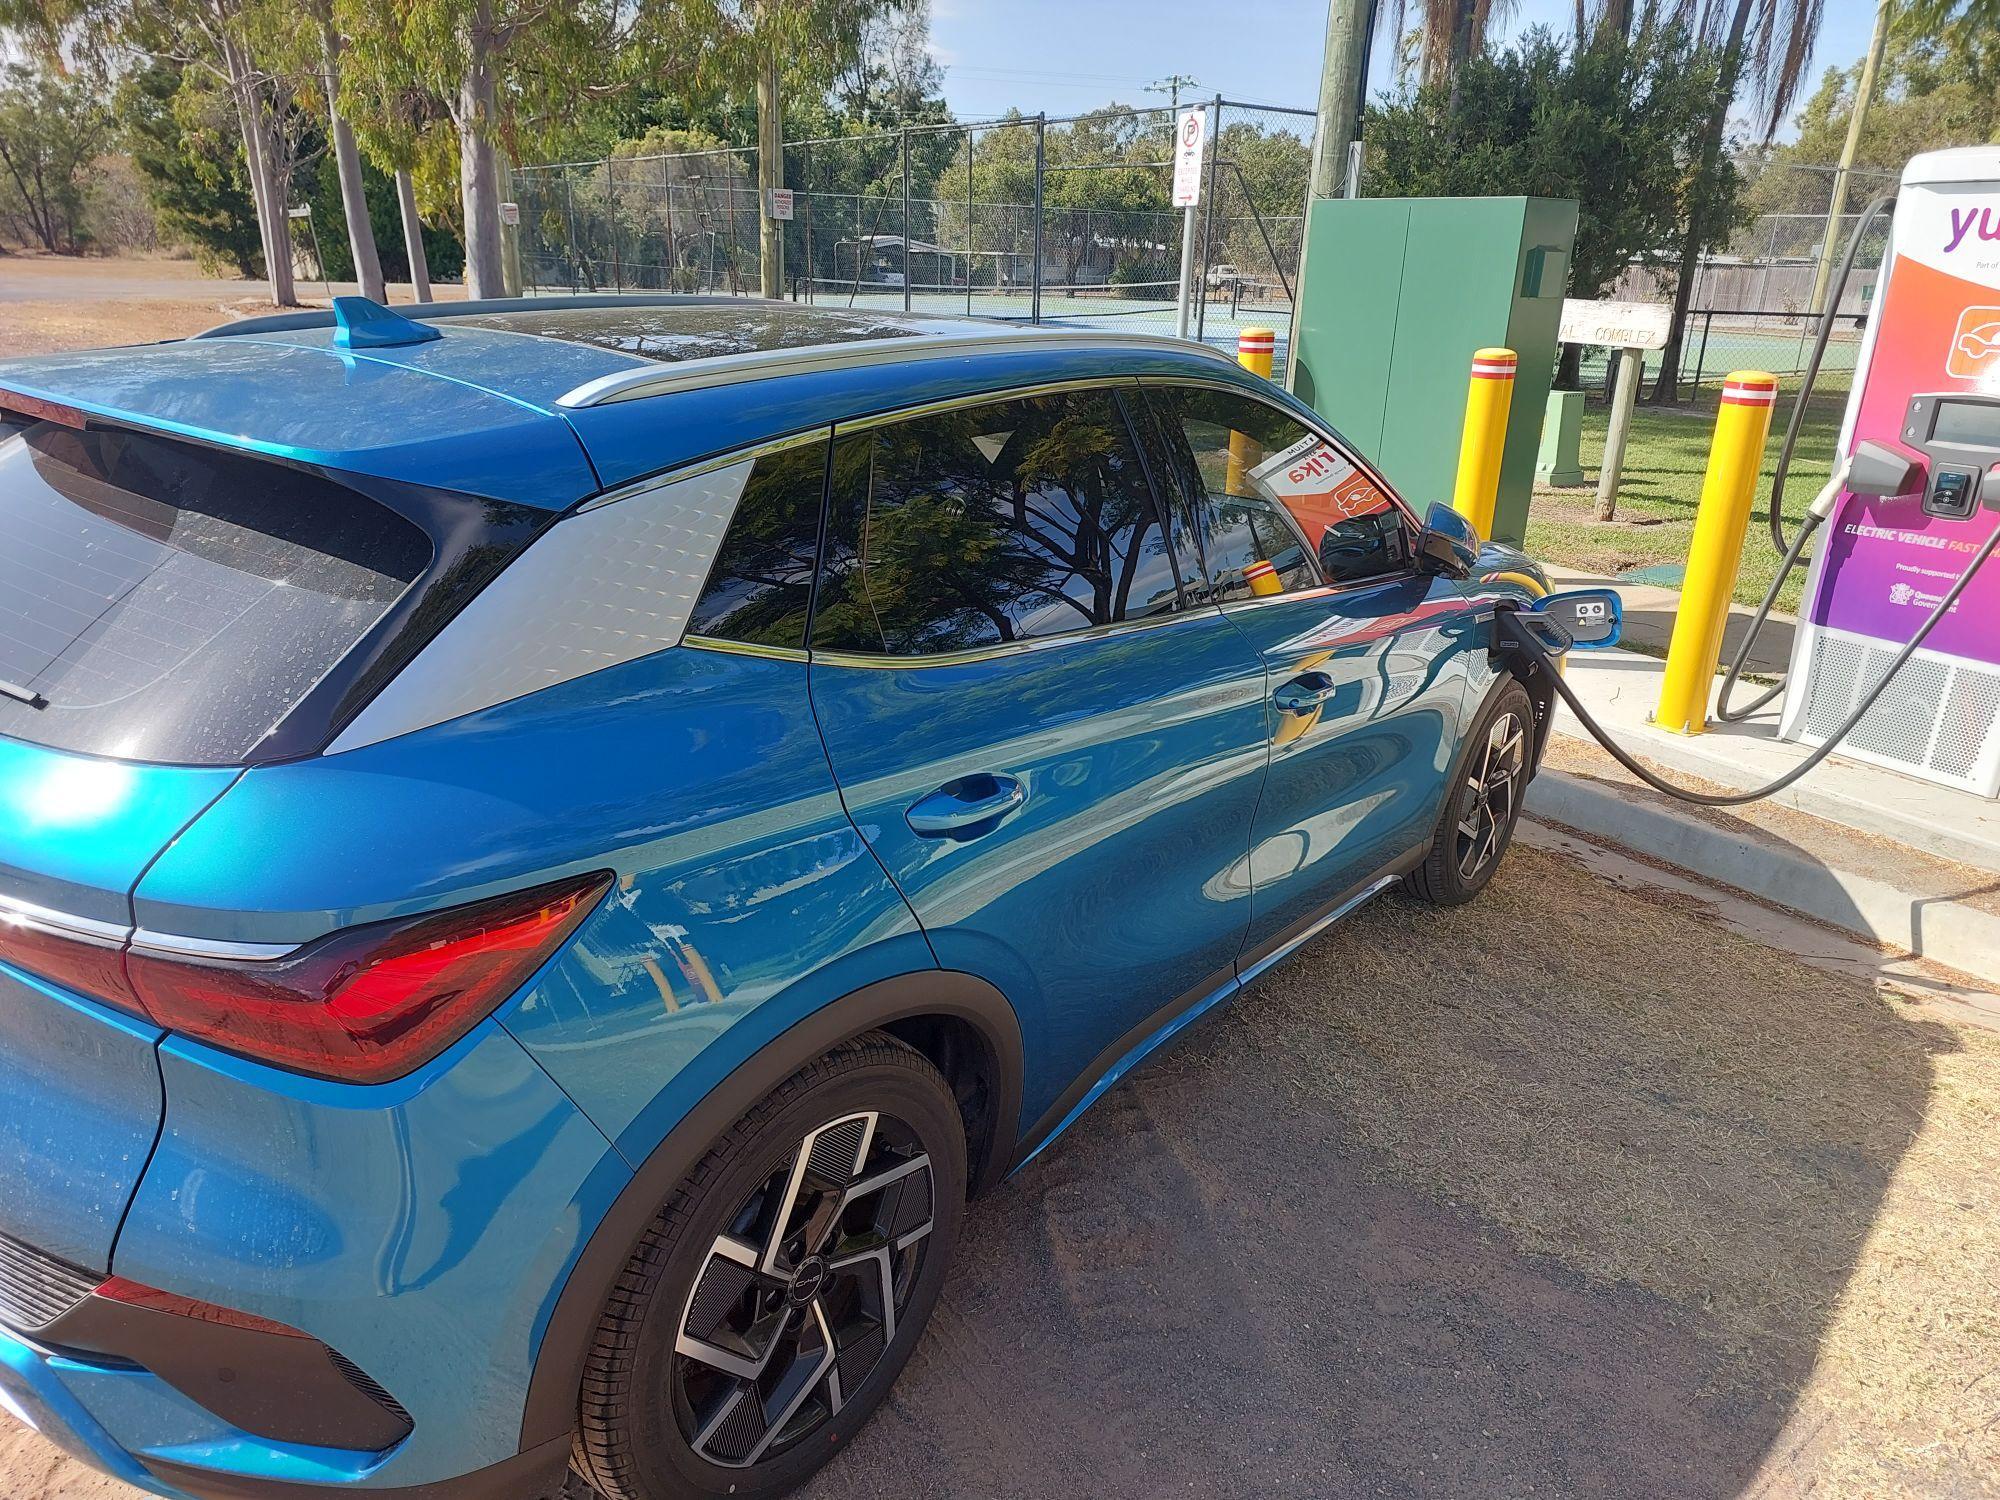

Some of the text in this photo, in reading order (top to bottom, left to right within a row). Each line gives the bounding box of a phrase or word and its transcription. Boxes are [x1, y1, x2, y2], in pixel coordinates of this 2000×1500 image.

[1976, 261, 1990, 269] Part
[1595, 326, 1657, 344] COMPLEX
[1844, 523, 1898, 541] ELECTRIC
[1898, 531, 1948, 550] VEHICLE
[1948, 540, 1980, 554] FAST
[1895, 562, 1920, 574] Proudly
[1920, 568, 1956, 580] supported
